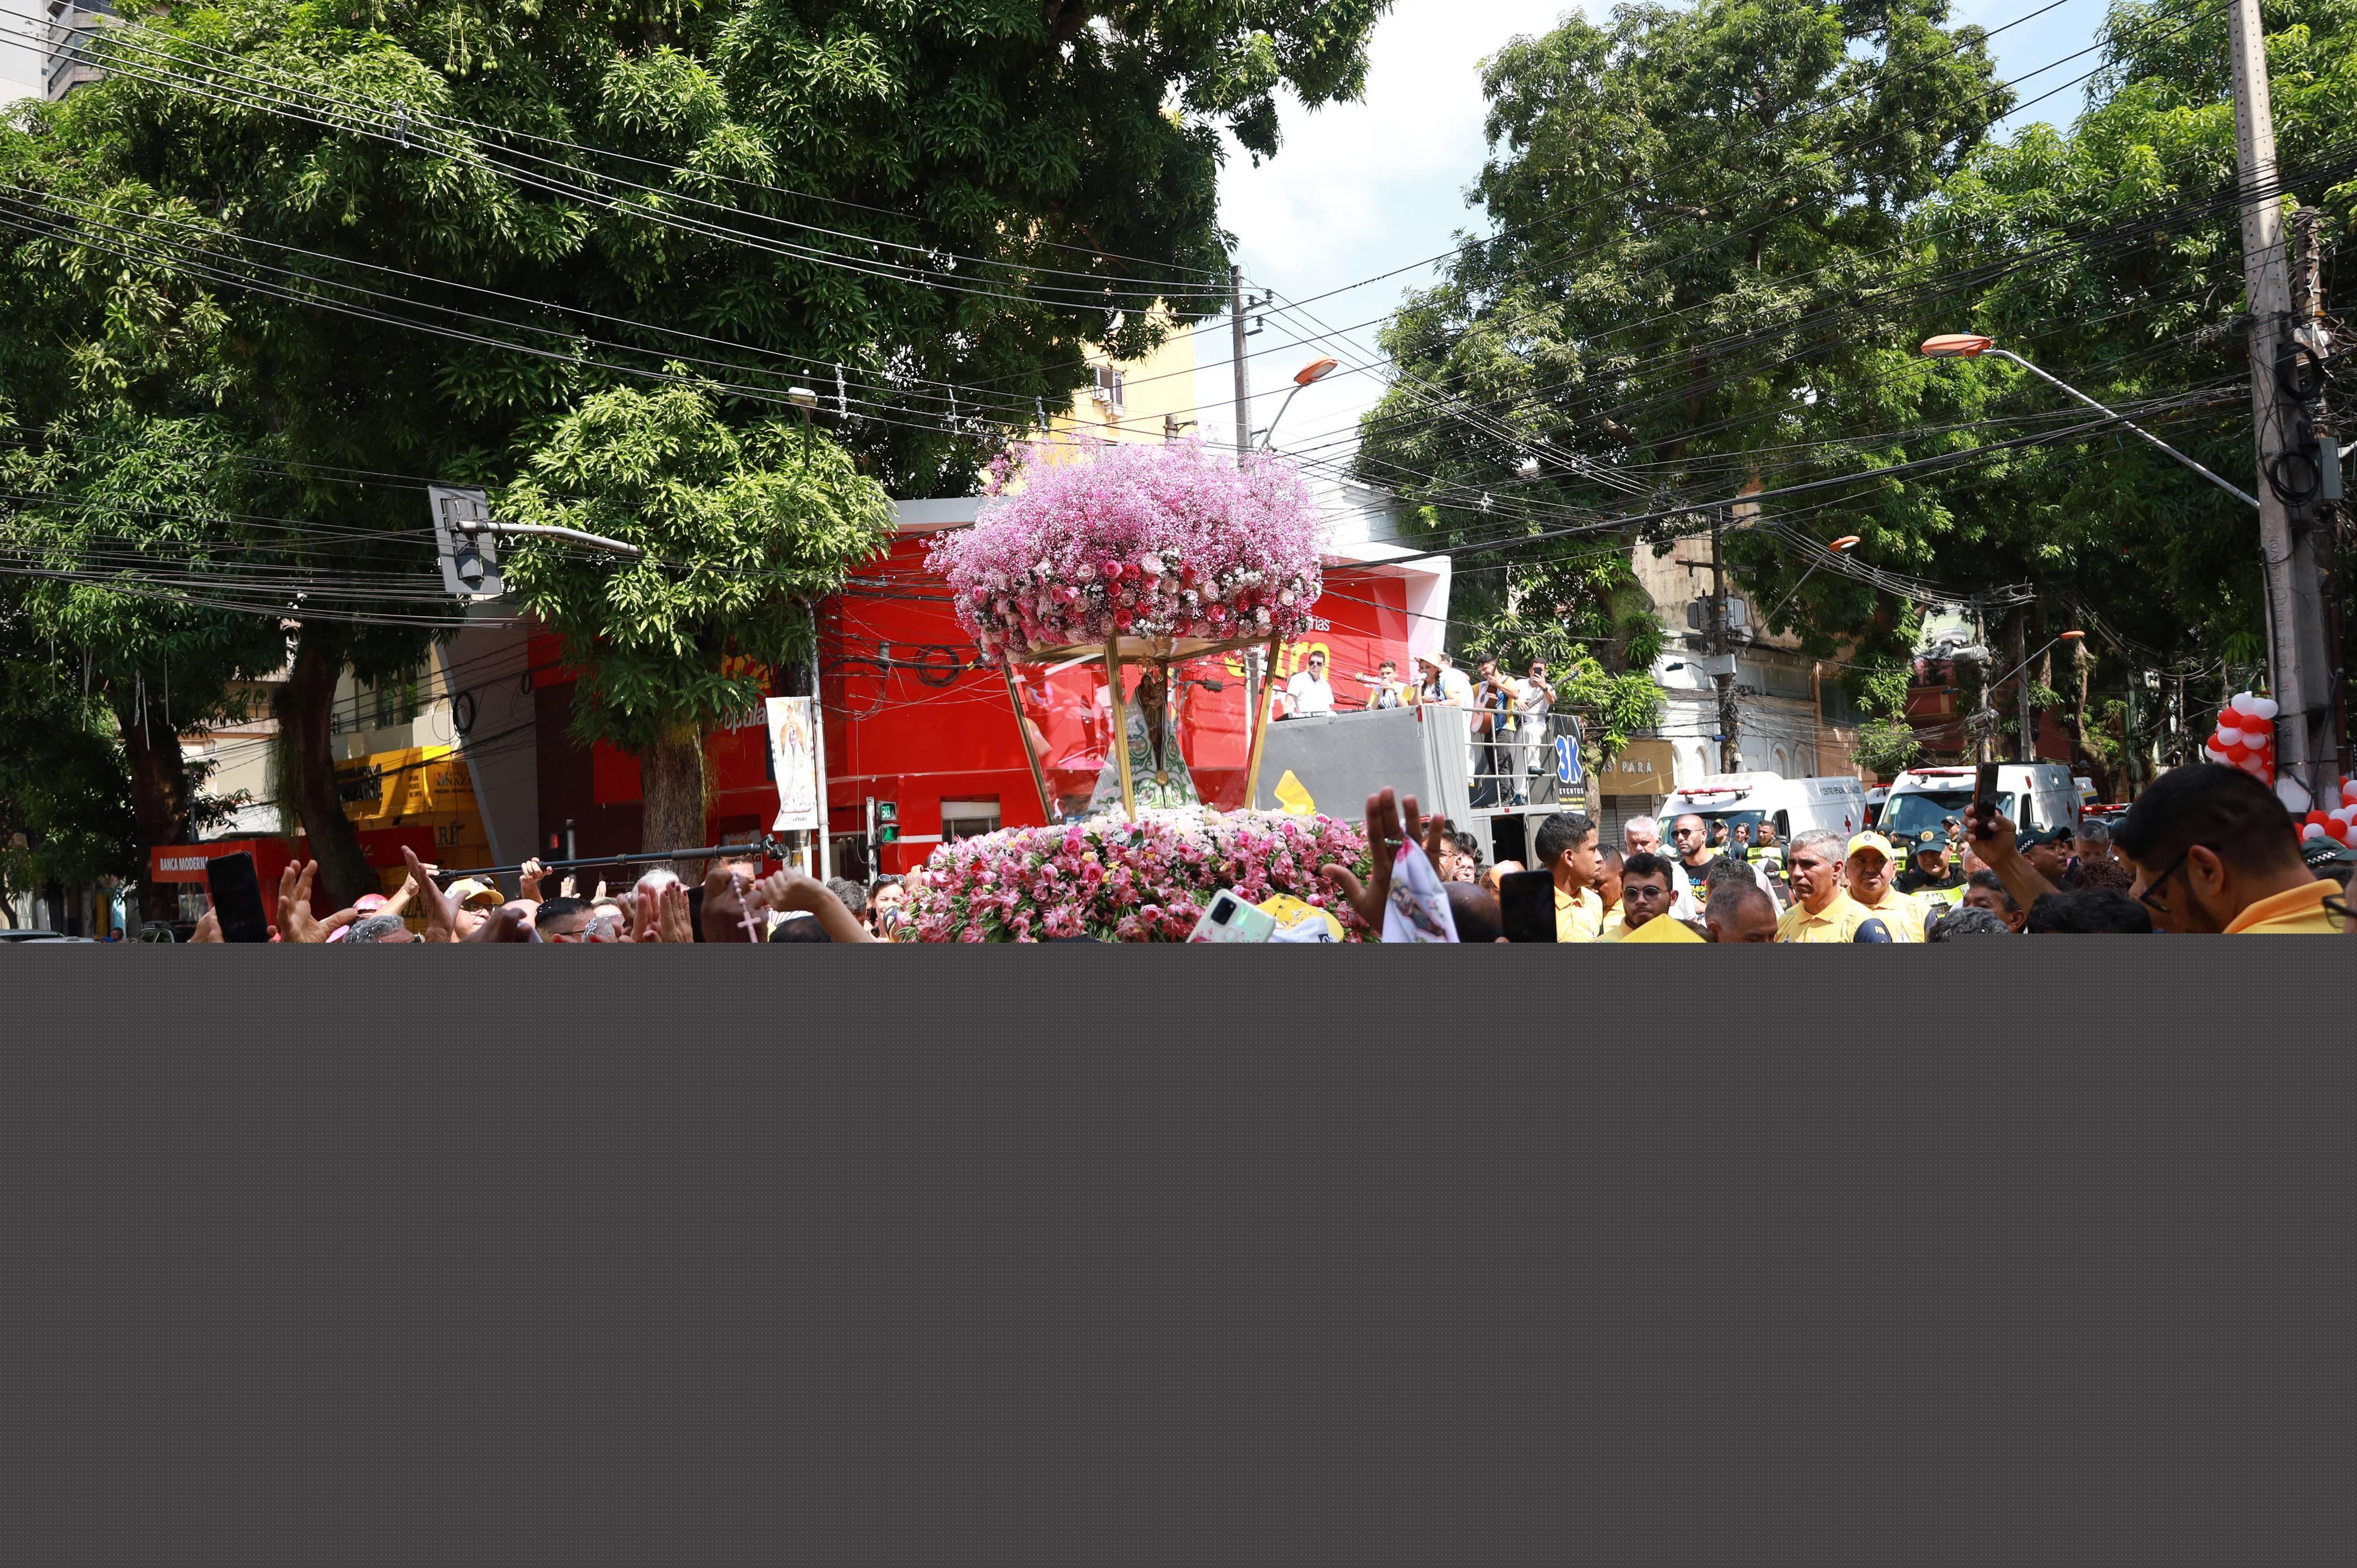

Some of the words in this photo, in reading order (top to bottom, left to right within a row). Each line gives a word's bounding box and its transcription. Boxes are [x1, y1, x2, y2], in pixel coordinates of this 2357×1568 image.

[1555, 734, 1583, 783] 3K
[1622, 759, 1653, 773] PARÁ
[160, 858, 178, 871] BANCA
